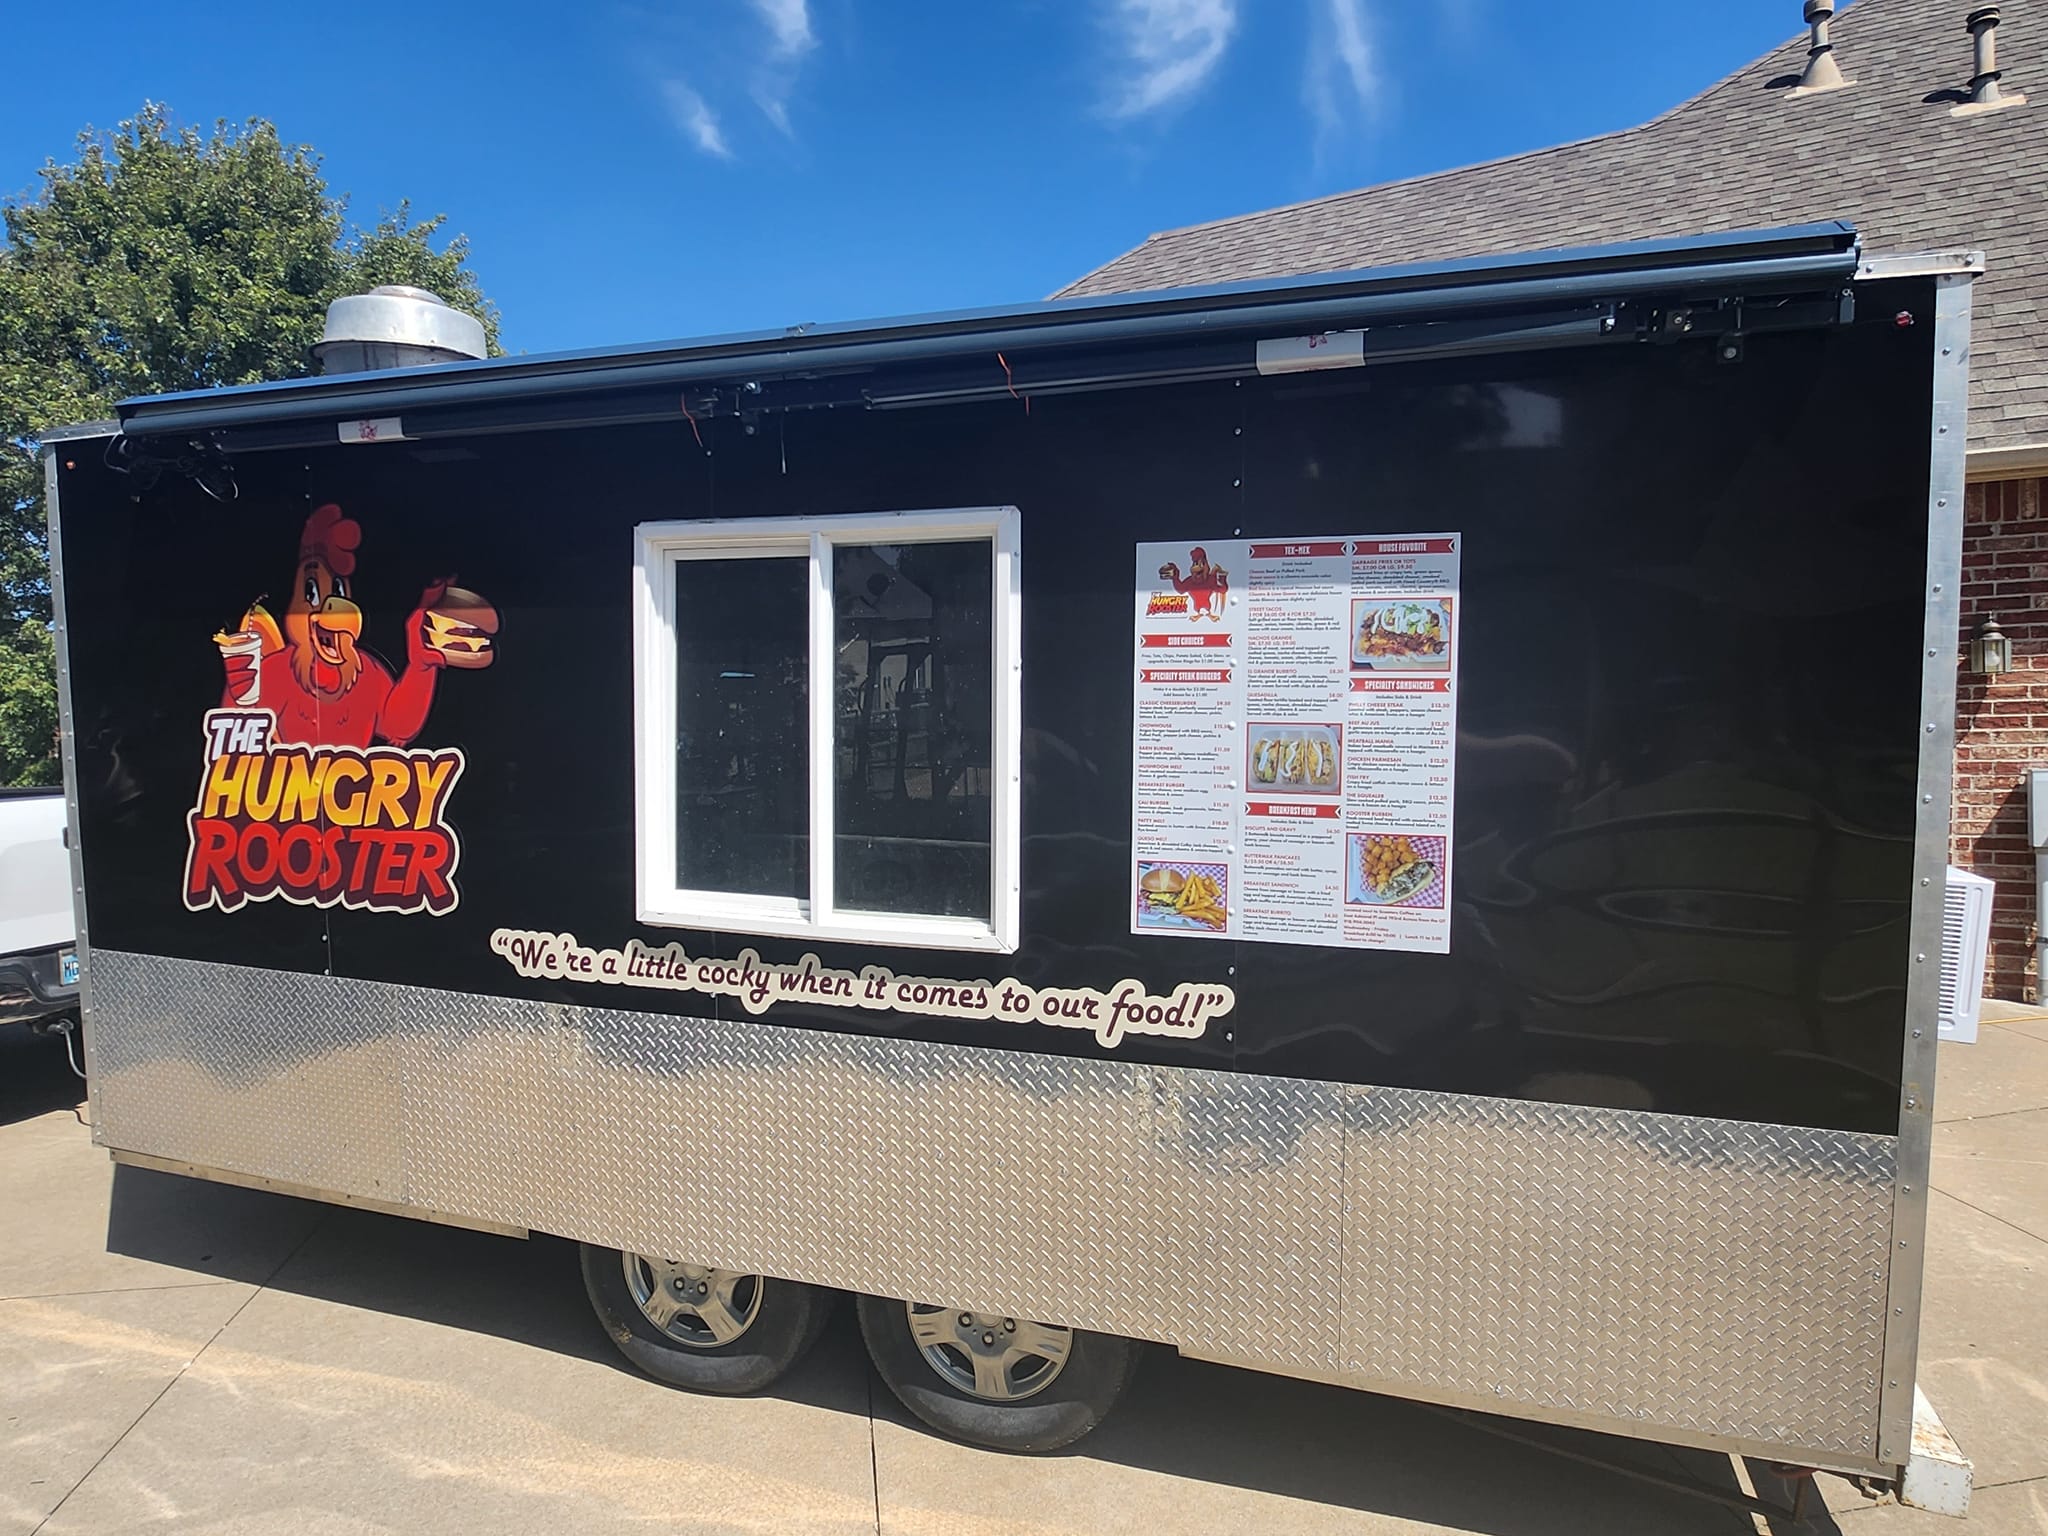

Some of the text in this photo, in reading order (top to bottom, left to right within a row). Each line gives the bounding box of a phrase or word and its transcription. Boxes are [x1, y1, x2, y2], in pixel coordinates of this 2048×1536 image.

[1285, 546, 1311, 555] TEX-MEX
[1379, 543, 1426, 552] HOUSE FAVORITE
[1152, 596, 1188, 605] HUNGRY
[1168, 637, 1204, 645] SIDE CHOICES
[1150, 672, 1221, 681] SPECIALTY STEAK BURGERS
[1365, 681, 1434, 690] SPECIALTY SANDWICHES
[208, 717, 269, 761] THE
[203, 755, 456, 831] HUNGRY
[1269, 805, 1316, 816] BREAKFAST MENU
[190, 820, 450, 899] ROOSTER
[602, 955, 618, 974] a
[627, 952, 688, 982] little
[698, 956, 772, 1004] cocky
[779, 961, 853, 997] when
[864, 973, 887, 1000] it
[897, 982, 989, 1009] comes
[1001, 986, 1031, 1014] to
[1042, 996, 1099, 1019] our
[1106, 987, 1225, 1039] food!”
